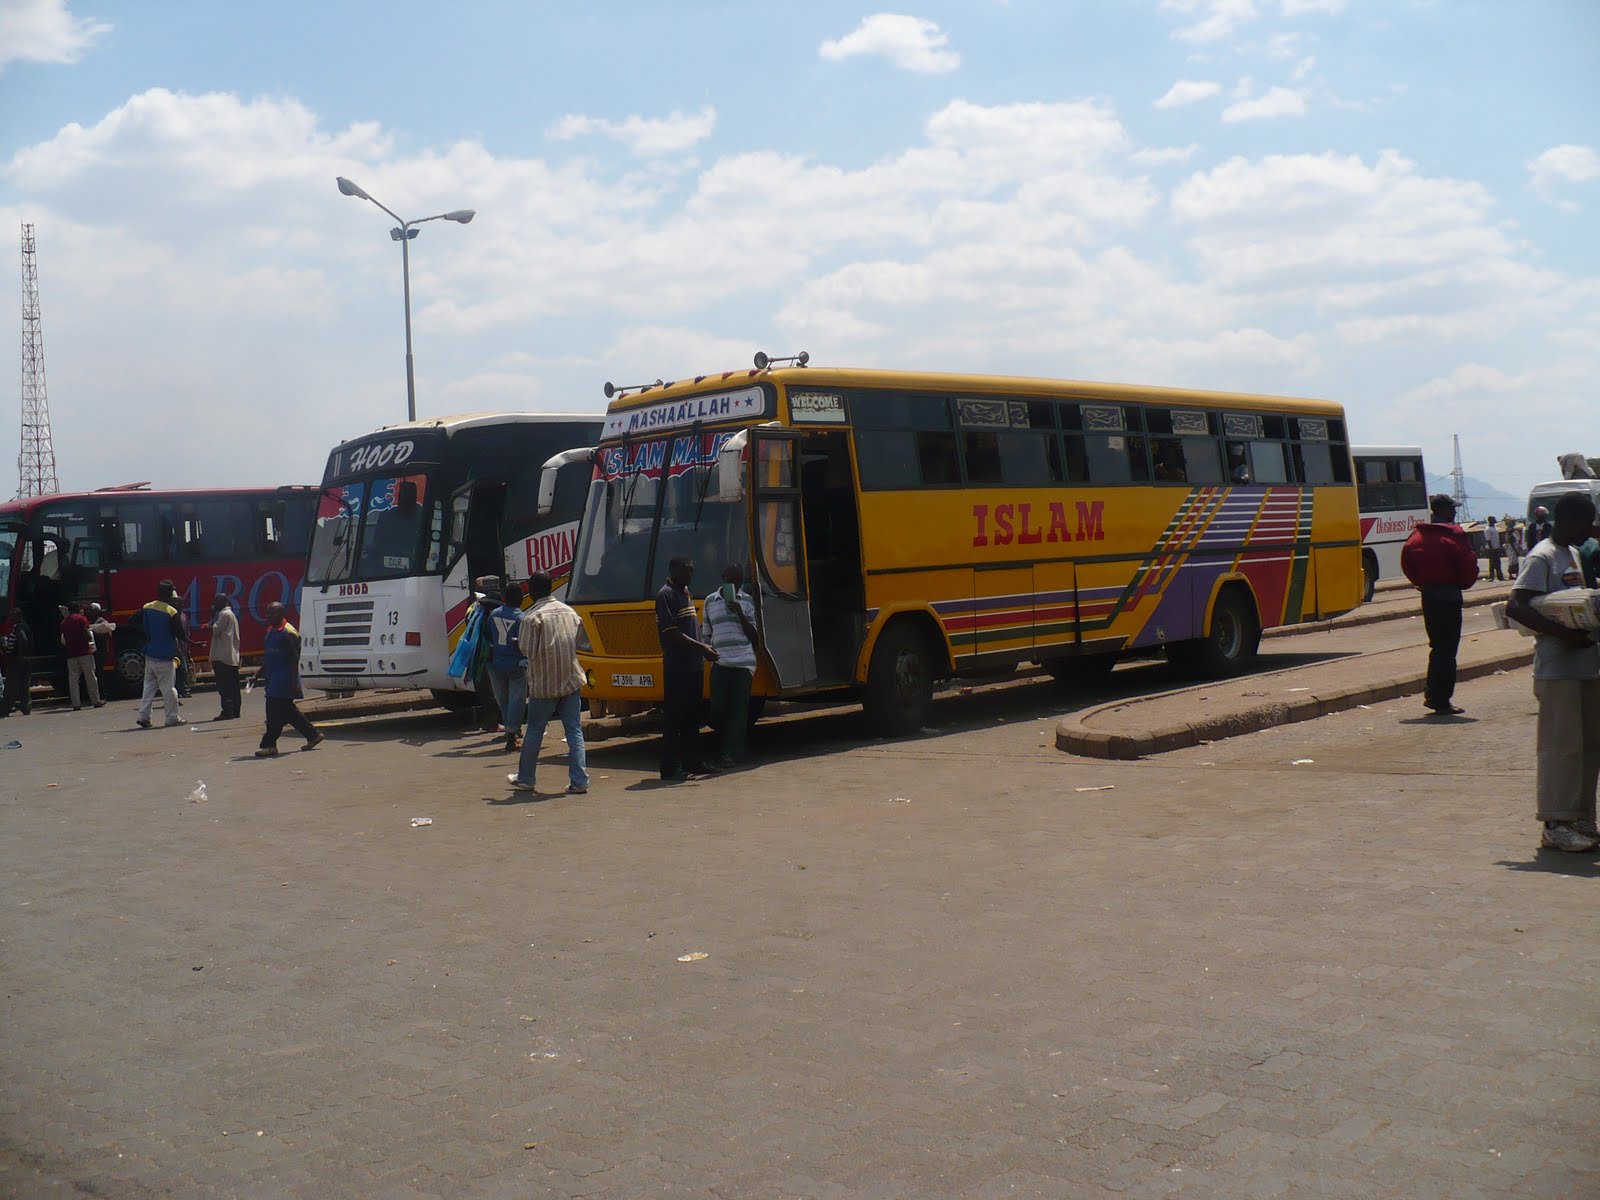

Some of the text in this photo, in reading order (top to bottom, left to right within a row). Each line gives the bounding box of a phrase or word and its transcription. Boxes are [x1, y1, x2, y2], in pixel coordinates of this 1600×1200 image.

[628, 397, 730, 431] MASHAALLAH
[791, 395, 839, 409] WELCOME
[350, 440, 414, 472] HOOD
[603, 440, 667, 475] ISLAM
[973, 501, 1104, 547] ISLAM
[1376, 516, 1406, 533] Business
[182, 570, 303, 628] ABO
[339, 583, 368, 596] HOOD
[388, 611, 398, 626] 13
